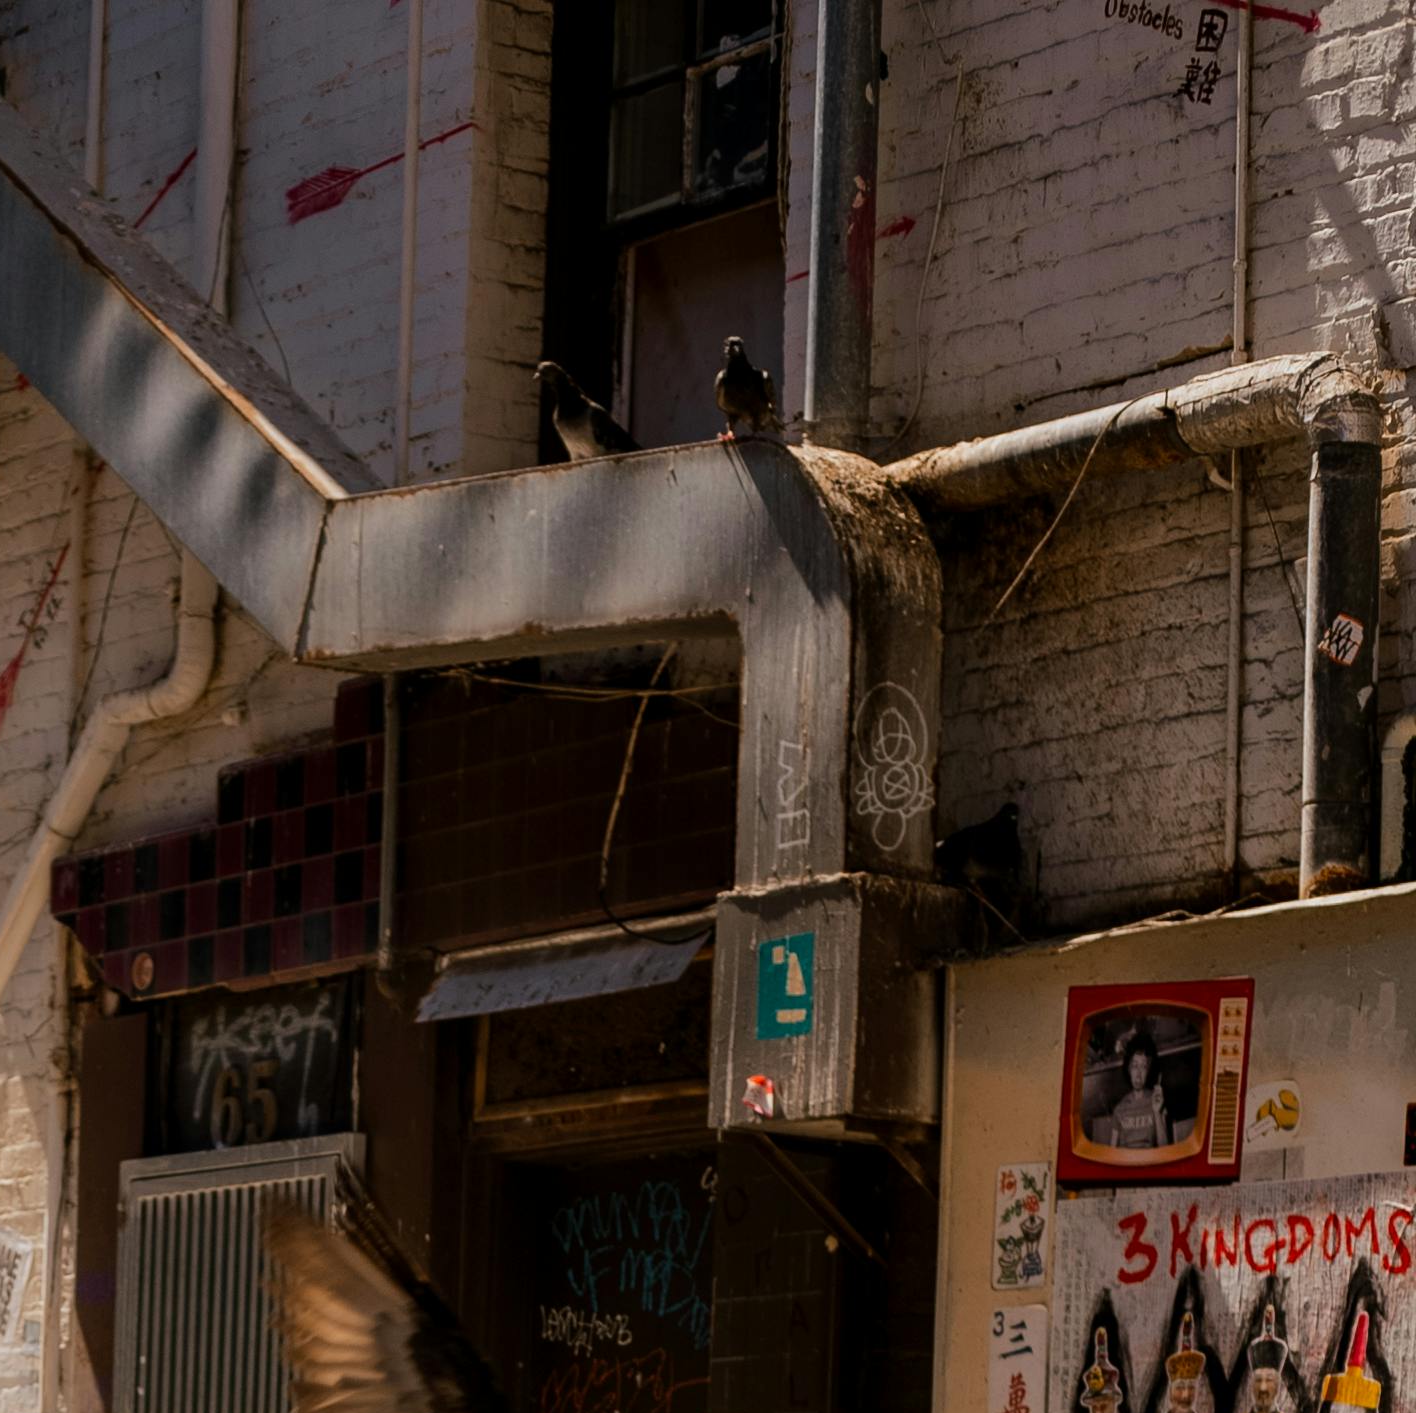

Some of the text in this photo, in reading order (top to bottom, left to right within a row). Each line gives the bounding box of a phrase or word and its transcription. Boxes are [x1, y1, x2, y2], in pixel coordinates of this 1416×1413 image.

[1175, 9, 1229, 106] 困難
[210, 1058, 280, 1149] 65
[1117, 1202, 1414, 1284] 3 KINGDOMS
[993, 1311, 1005, 1337] 3
